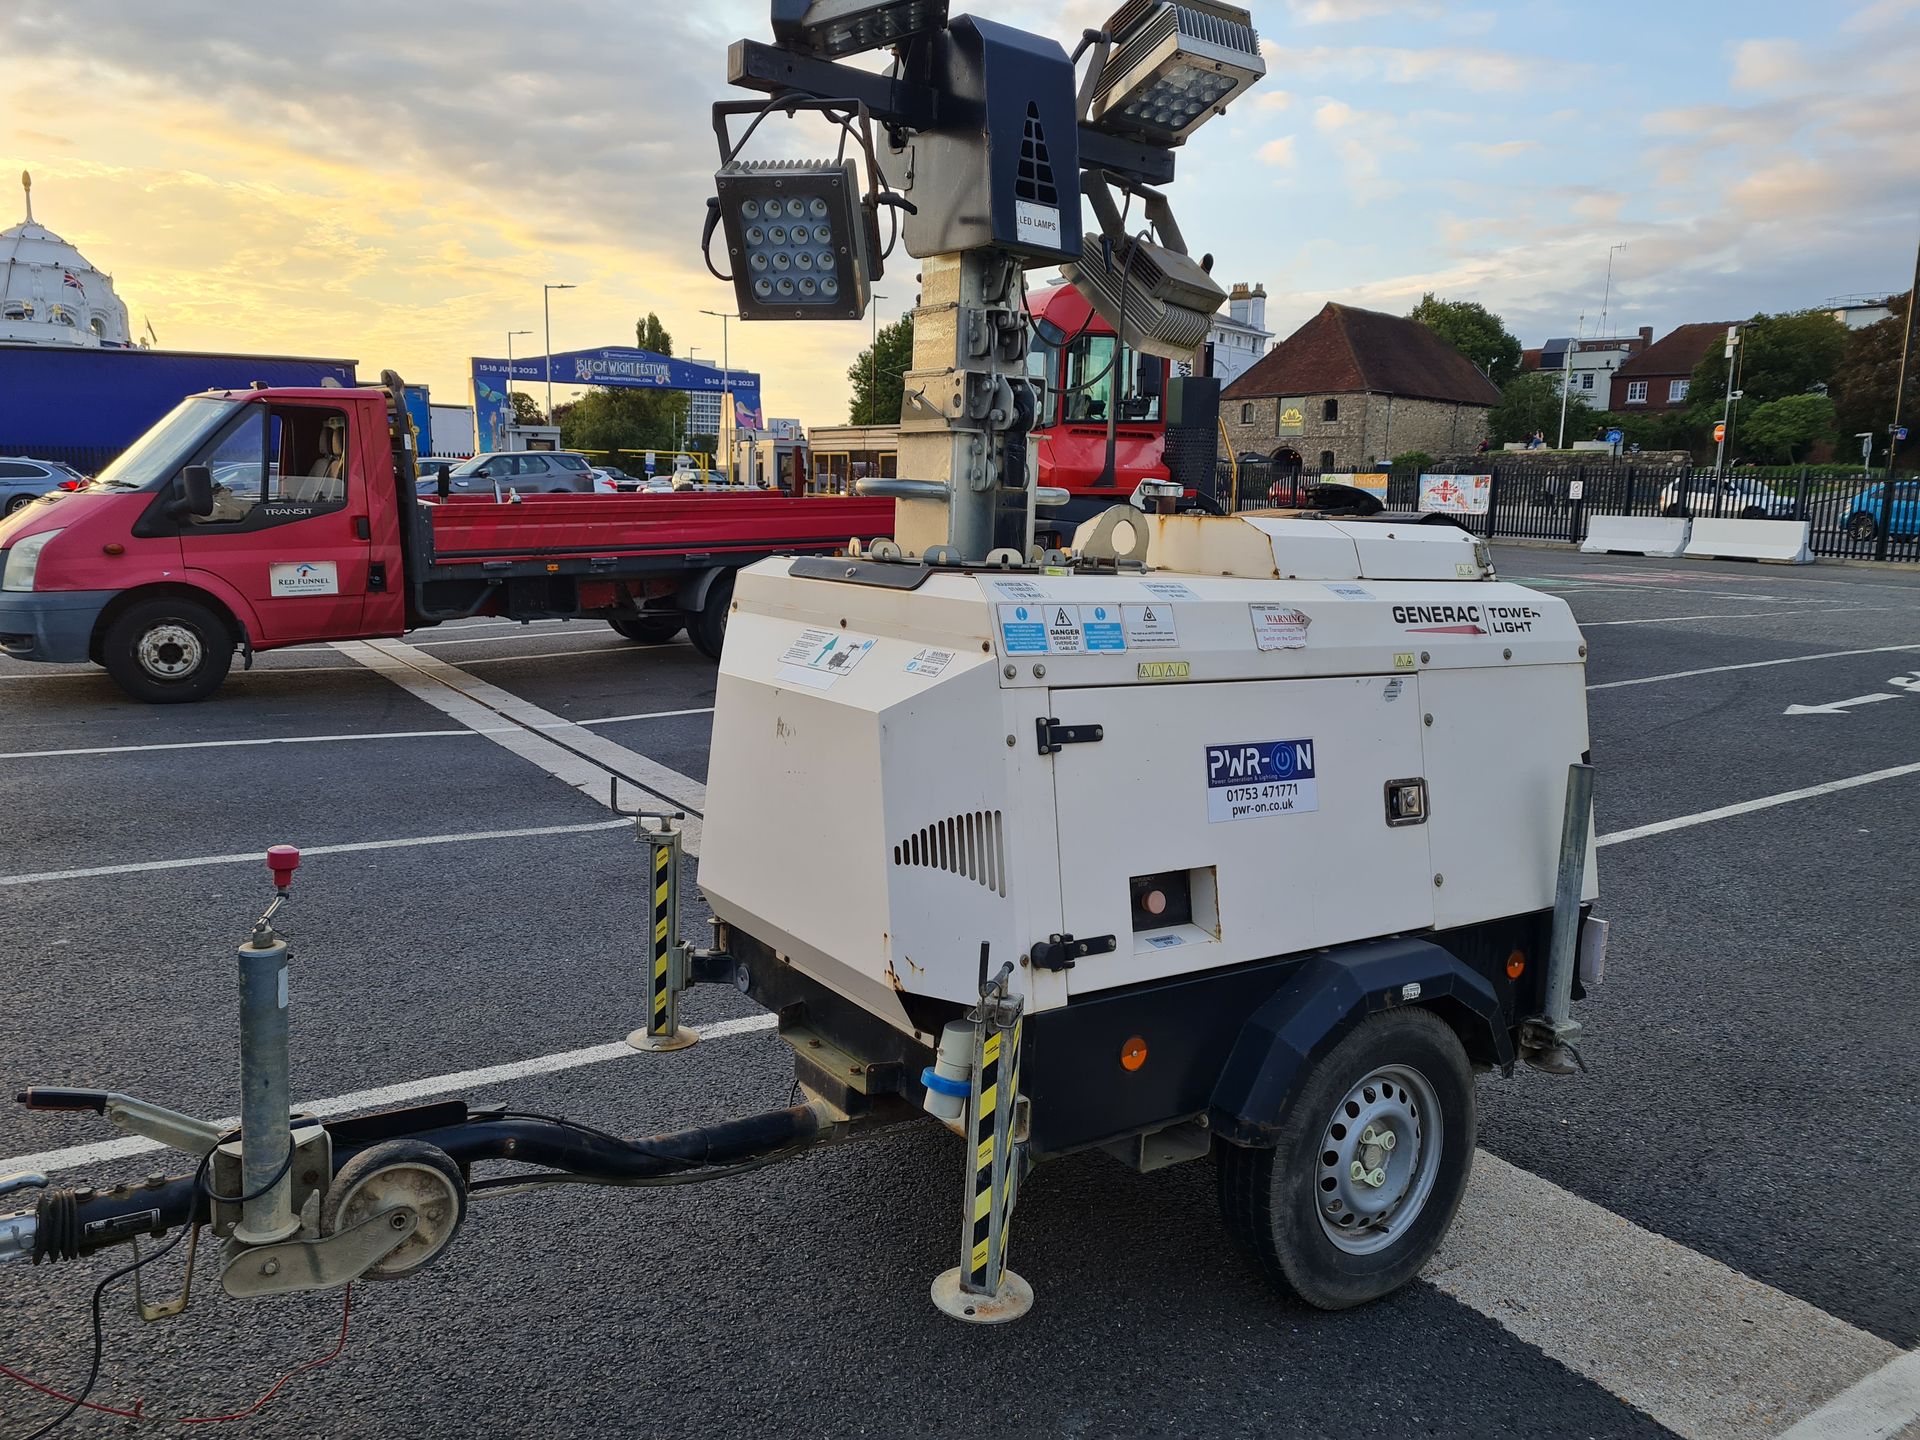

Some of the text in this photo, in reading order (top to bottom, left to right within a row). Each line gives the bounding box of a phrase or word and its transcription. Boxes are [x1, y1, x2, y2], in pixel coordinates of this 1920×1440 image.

[1020, 216, 1056, 231] LED LAMPS
[480, 364, 497, 372] 15-18
[577, 360, 669, 376] ISLE OF WIGHT FESTIVAL
[264, 507, 313, 516] TRANSIT
[297, 577, 331, 585] FUNNEL
[1264, 614, 1305, 623] WARNING
[1392, 605, 1480, 624] GENERAC
[1493, 621, 1532, 633] LIGHT
[1226, 783, 1298, 802] 01753 471771
[1232, 798, 1294, 818] pwr-on.co.uk
